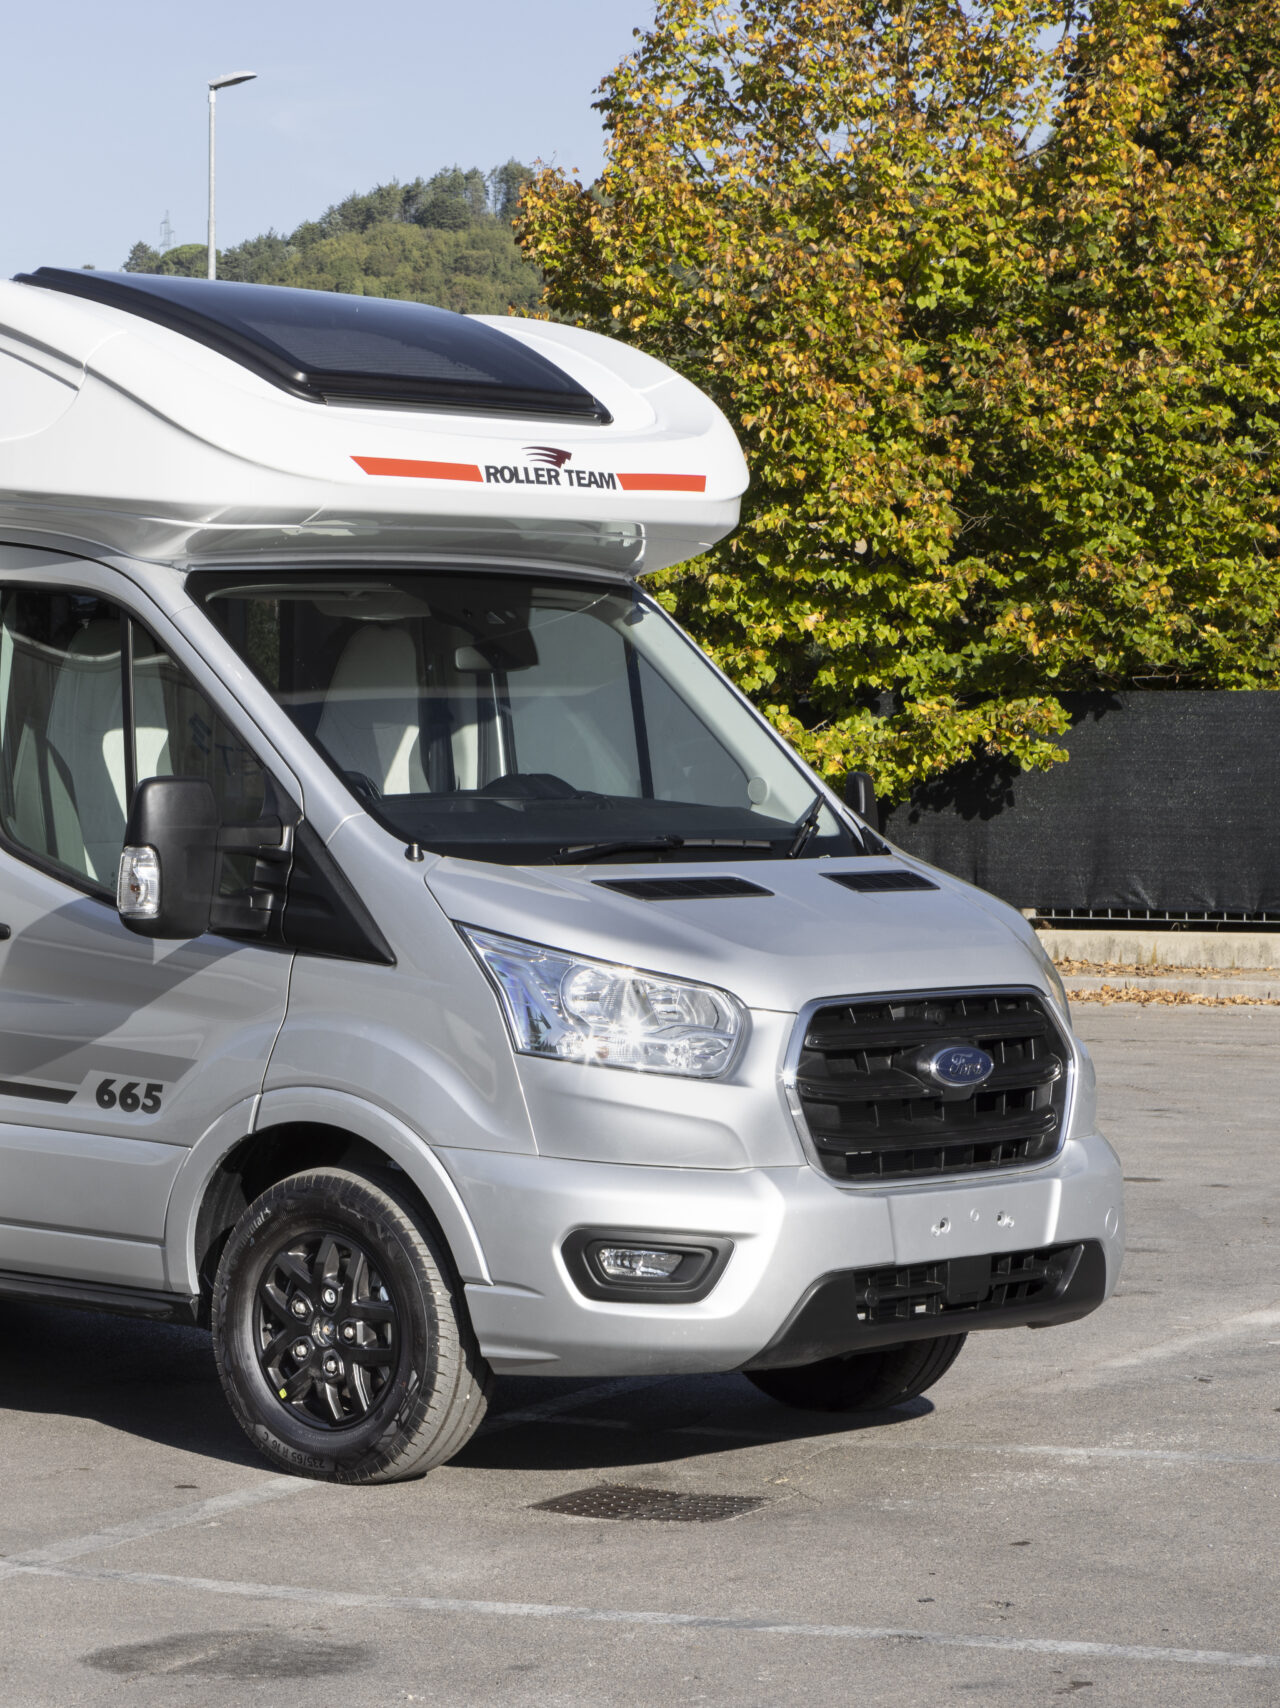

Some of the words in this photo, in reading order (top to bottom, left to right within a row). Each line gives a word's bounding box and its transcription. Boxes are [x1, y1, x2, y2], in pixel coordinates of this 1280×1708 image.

[484, 465, 561, 486] ROLLER
[564, 469, 617, 490] TEAM
[949, 1053, 983, 1077] Ford
[95, 1078, 163, 1115] 665
